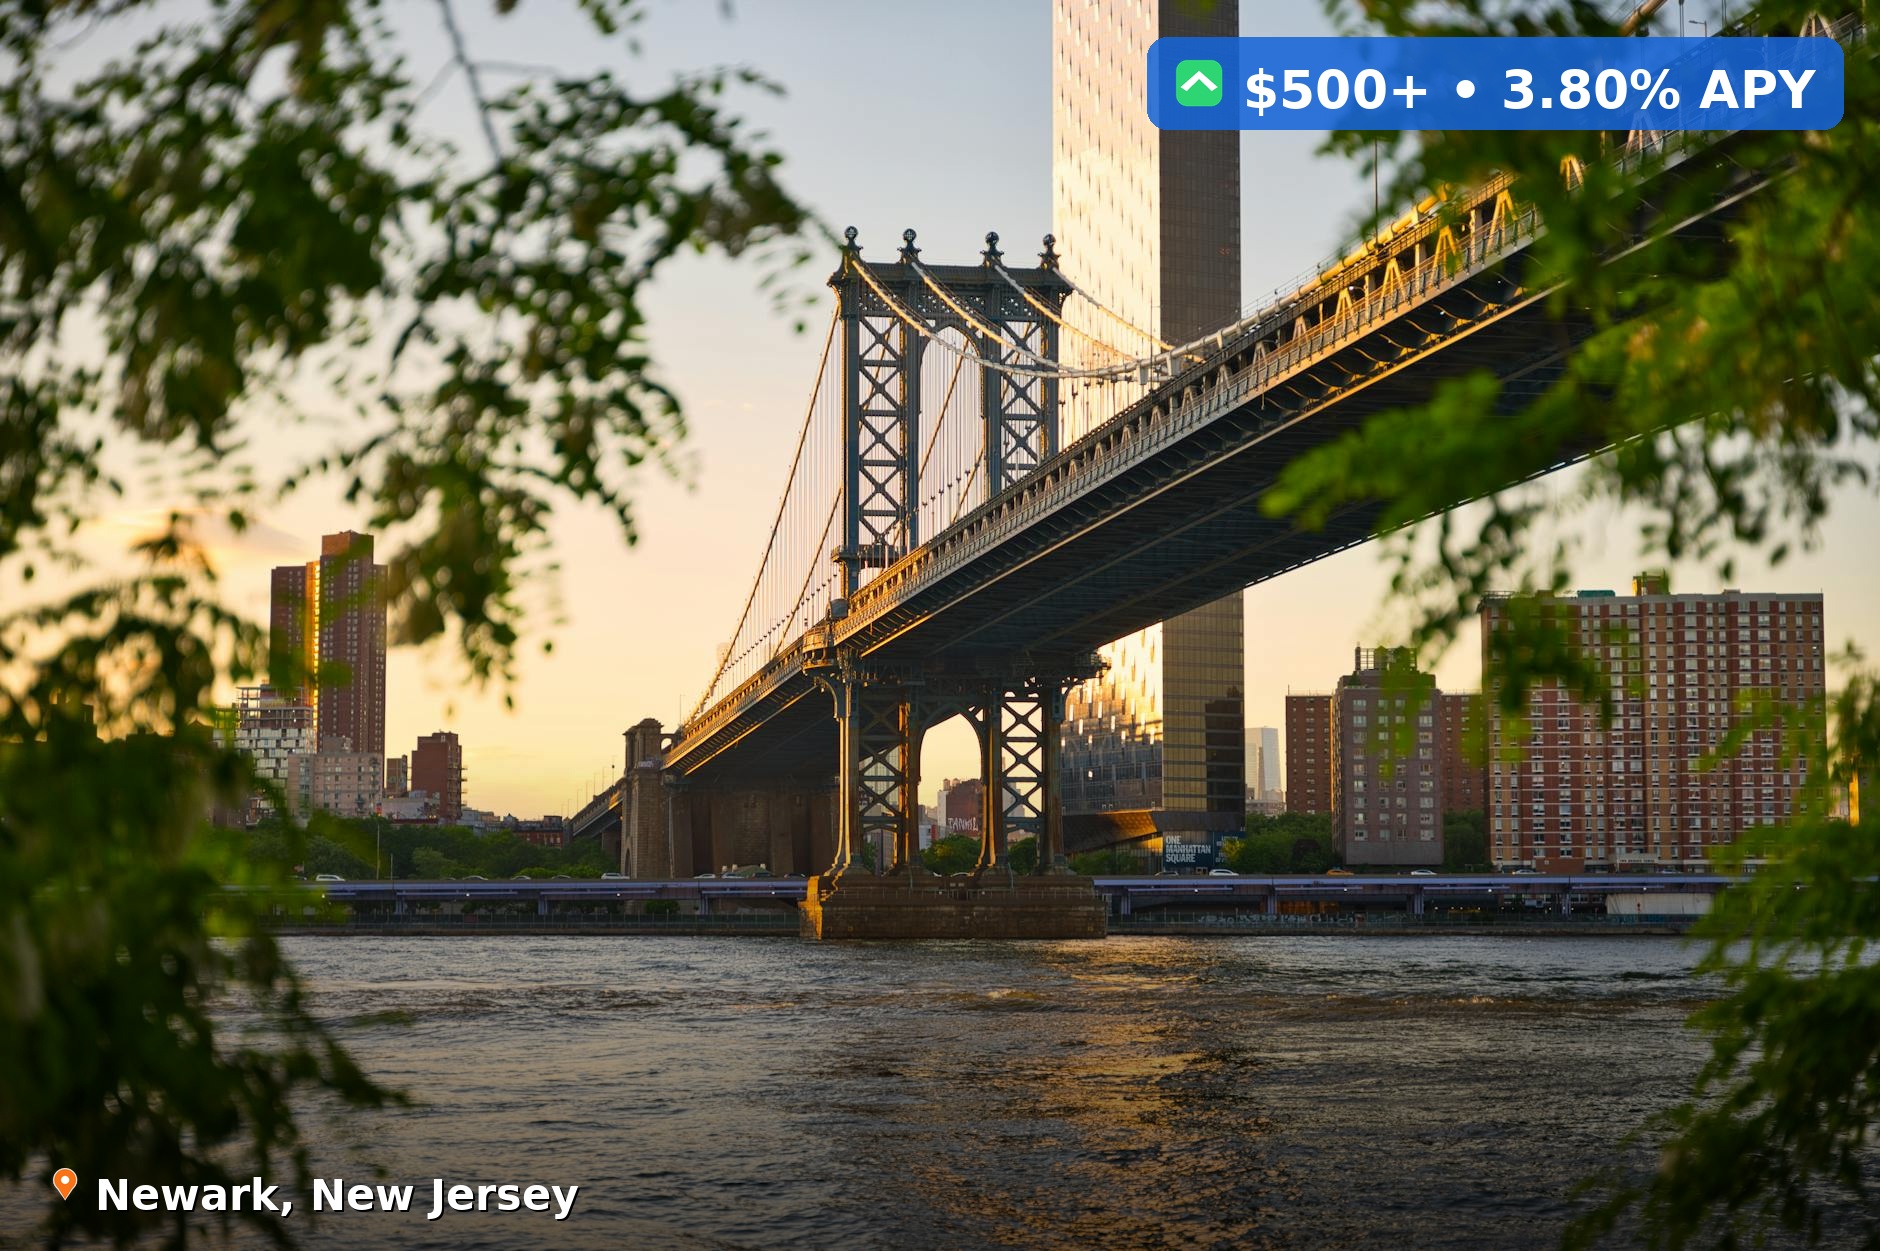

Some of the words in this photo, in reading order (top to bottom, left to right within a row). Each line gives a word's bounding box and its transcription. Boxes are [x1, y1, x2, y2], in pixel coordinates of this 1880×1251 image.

[1165, 835, 1182, 845] ONE
[1165, 844, 1211, 854] MANHATTAN
[1165, 853, 1196, 864] SQUARE
